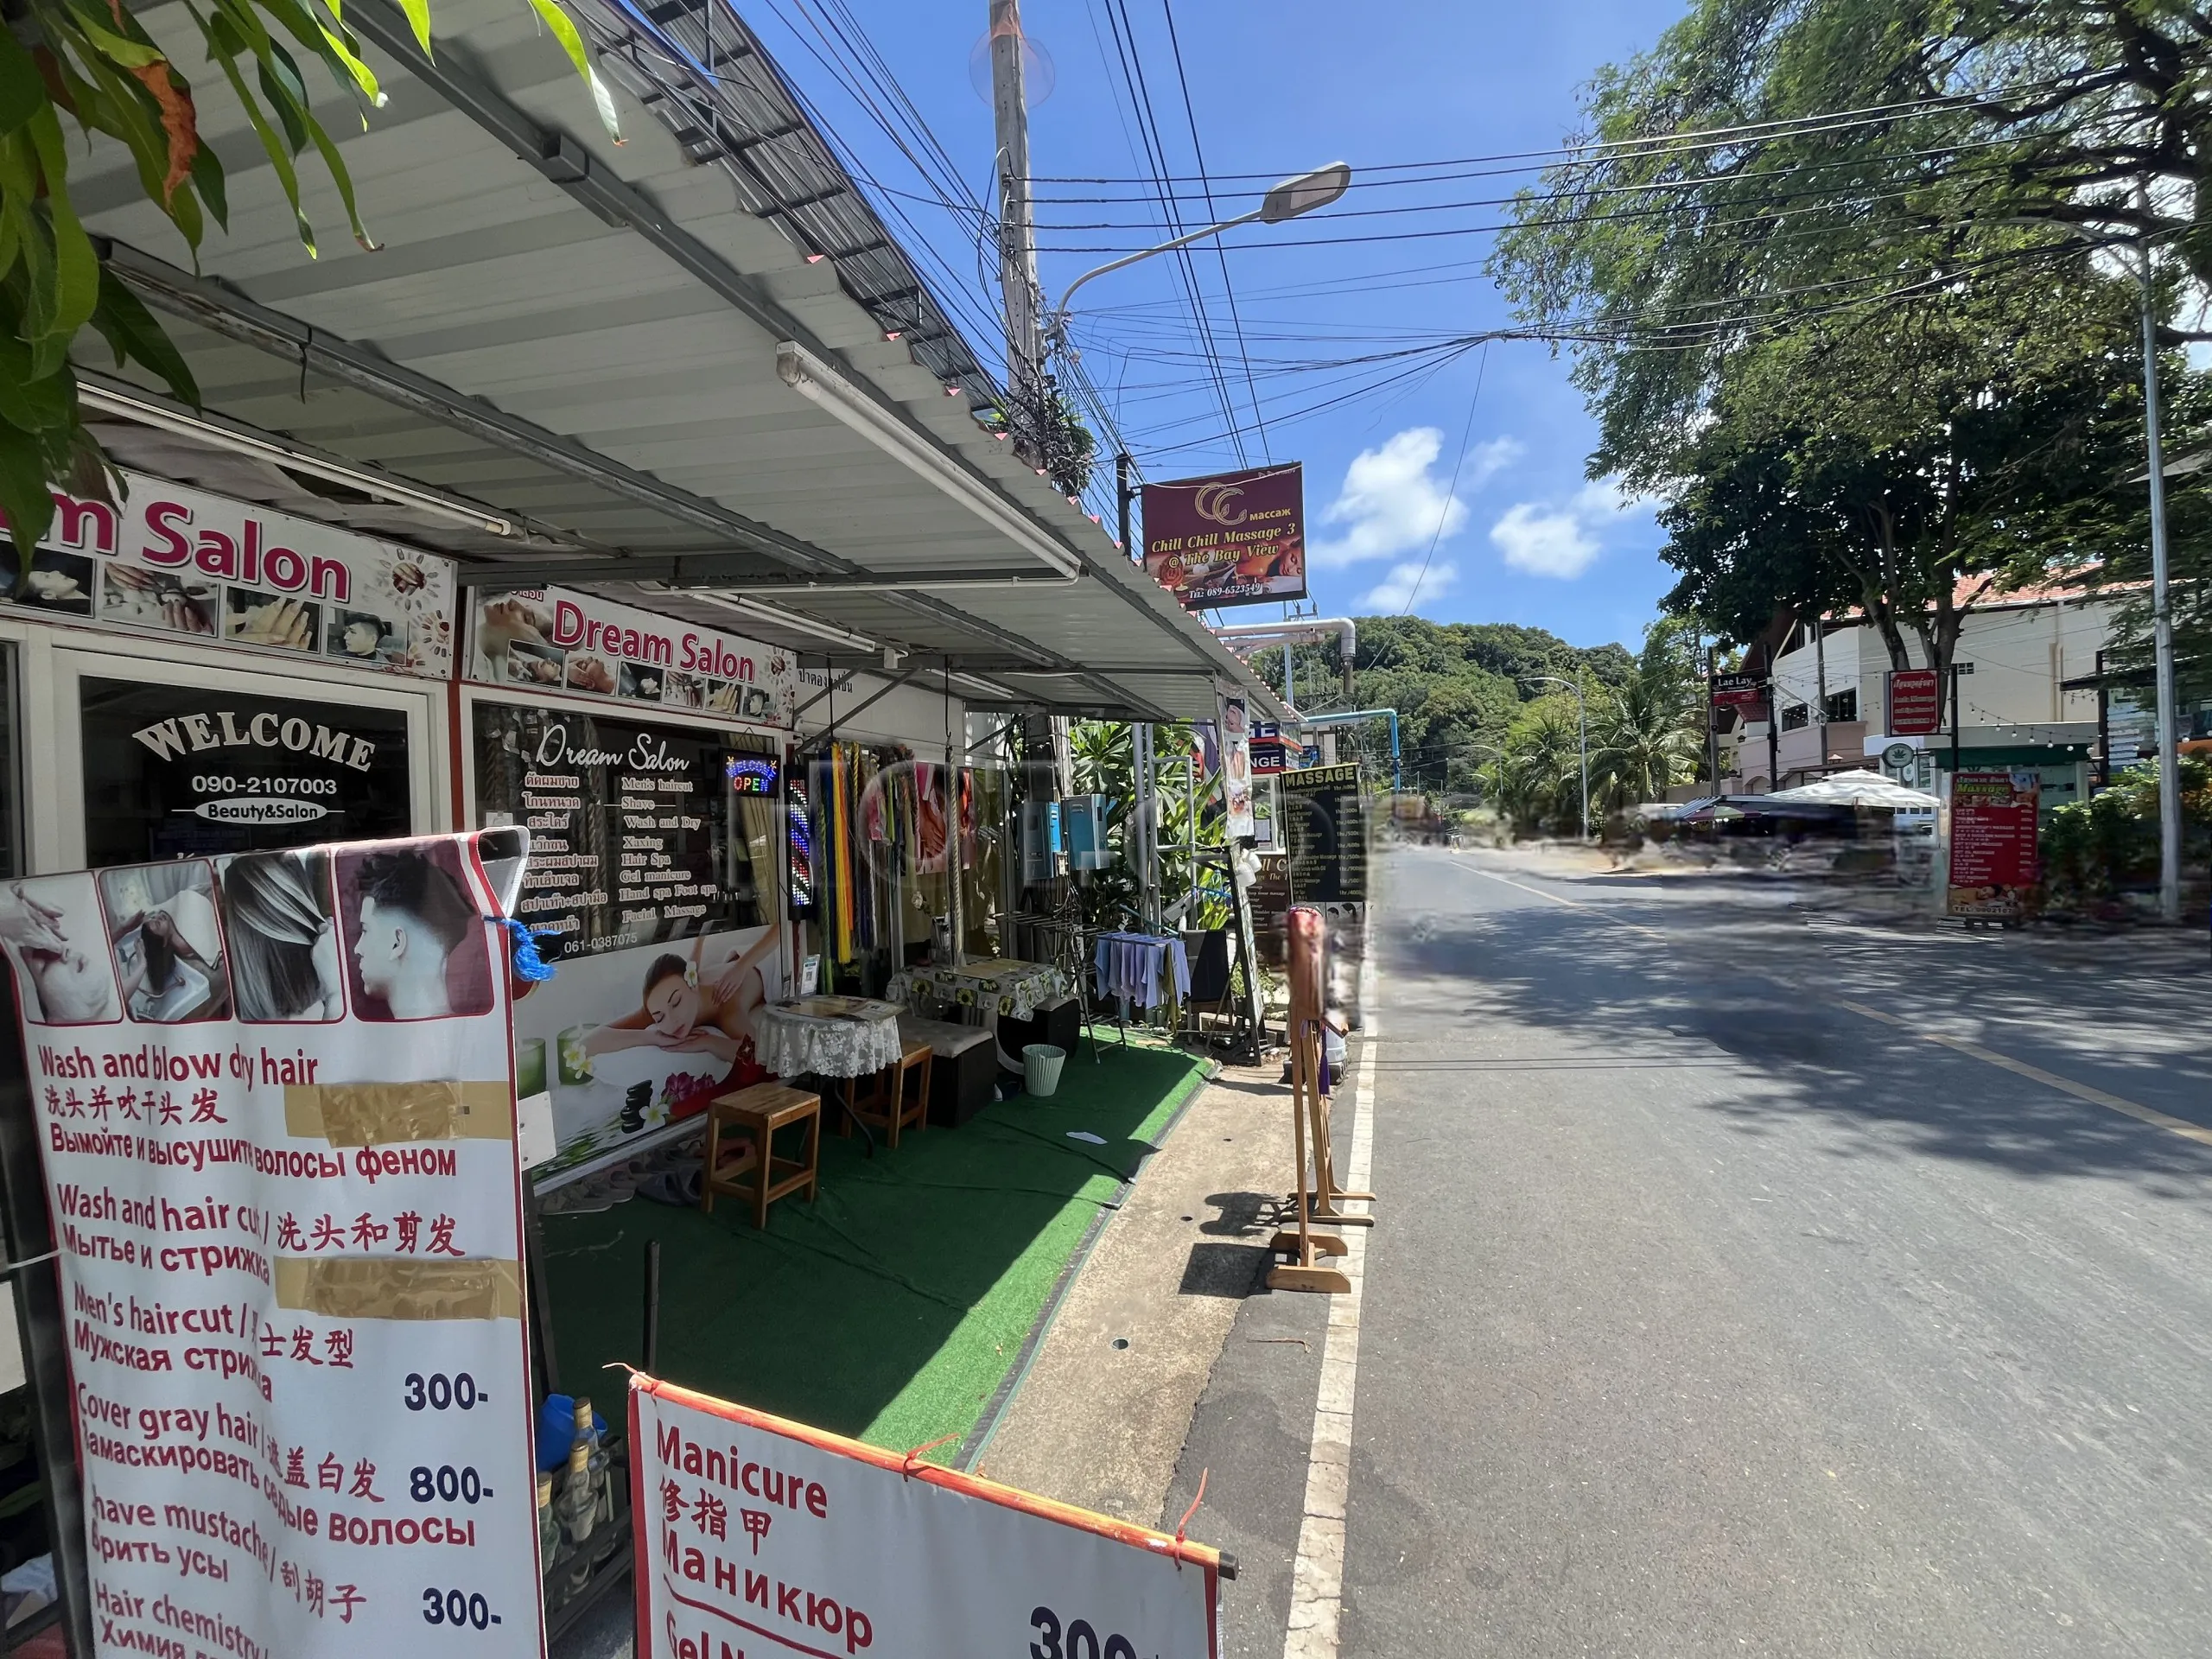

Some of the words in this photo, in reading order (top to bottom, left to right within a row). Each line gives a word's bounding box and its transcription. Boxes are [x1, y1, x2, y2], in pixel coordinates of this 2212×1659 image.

[1249, 508, 1292, 521] массаж
[141, 499, 350, 602] Salon
[1152, 537, 1182, 553] Chill
[1187, 533, 1218, 550] Chill
[1224, 526, 1282, 544] Massage
[1287, 523, 1296, 535] 3
[1184, 552, 1210, 566] The
[1214, 548, 1241, 564] Bay
[1247, 543, 1279, 557] View
[552, 600, 673, 667] Dream
[680, 632, 756, 683] Salon
[133, 711, 376, 772] WELCOME
[536, 724, 623, 766] Dream
[628, 733, 690, 771] Salon
[1249, 756, 1281, 767] NGE
[192, 775, 338, 795] 090-2107003
[621, 777, 655, 791] Men's
[658, 779, 694, 792] haircut
[726, 760, 776, 781] WELCOME
[734, 776, 768, 791] OPEN
[1285, 766, 1355, 787] MASSAGE
[1956, 784, 2009, 795] Massage
[207, 803, 319, 821] Beauty&Salon
[621, 796, 655, 810] Shave
[624, 815, 657, 829] Wash
[659, 815, 678, 829] and
[681, 816, 702, 831] Dry
[620, 869, 641, 883] Gel
[645, 868, 691, 882] manicure
[621, 853, 647, 866] Hair
[651, 853, 671, 867] Spa
[619, 887, 650, 902] Hand
[653, 887, 672, 900] spa
[674, 884, 698, 897] Foot
[700, 884, 717, 897] spa
[622, 907, 657, 924] Facial
[664, 905, 707, 919] Massage
[564, 933, 638, 953] 061-0387075
[38, 1044, 97, 1079] Wash
[103, 1044, 149, 1079] and
[152, 1045, 221, 1081] blow
[229, 1043, 254, 1093] dry
[260, 1046, 318, 1085] hair
[45, 1084, 228, 1126] 洗头并吹干头发
[50, 1122, 133, 1159] Вымойте
[137, 1137, 145, 1161] и
[255, 1144, 346, 1179] волосы
[355, 1145, 457, 1185] феном
[57, 1183, 117, 1221] Wash
[122, 1196, 156, 1231] and
[162, 1196, 230, 1232] hair
[277, 1211, 466, 1256] 洗头和剪发
[62, 1223, 135, 1264] Мытье
[141, 1244, 153, 1269] и
[161, 1244, 270, 1287] стрижка
[74, 1281, 124, 1326] Men's
[130, 1295, 234, 1335] haircut
[74, 1319, 173, 1371] Мужская
[184, 1347, 273, 1403] стрижа
[404, 1372, 490, 1412] 300-
[79, 1382, 131, 1430] Cover
[139, 1408, 209, 1442] gray
[216, 1402, 257, 1449] hair
[85, 1421, 260, 1490] амаскировать
[264, 1474, 319, 1536] седые
[328, 1512, 475, 1547] волосы
[410, 1465, 494, 1504] 800-
[657, 1418, 828, 1519] Manicure
[92, 1484, 156, 1527] have
[164, 1504, 269, 1573] mustache
[659, 1474, 772, 1556] 修指甲
[177, 1546, 228, 1583] усы
[662, 1516, 874, 1656] Маникюр
[95, 1578, 145, 1618] Hair
[152, 1593, 260, 1659] chemistry
[423, 1587, 502, 1630] 300-
[99, 1614, 186, 1659] Химия
